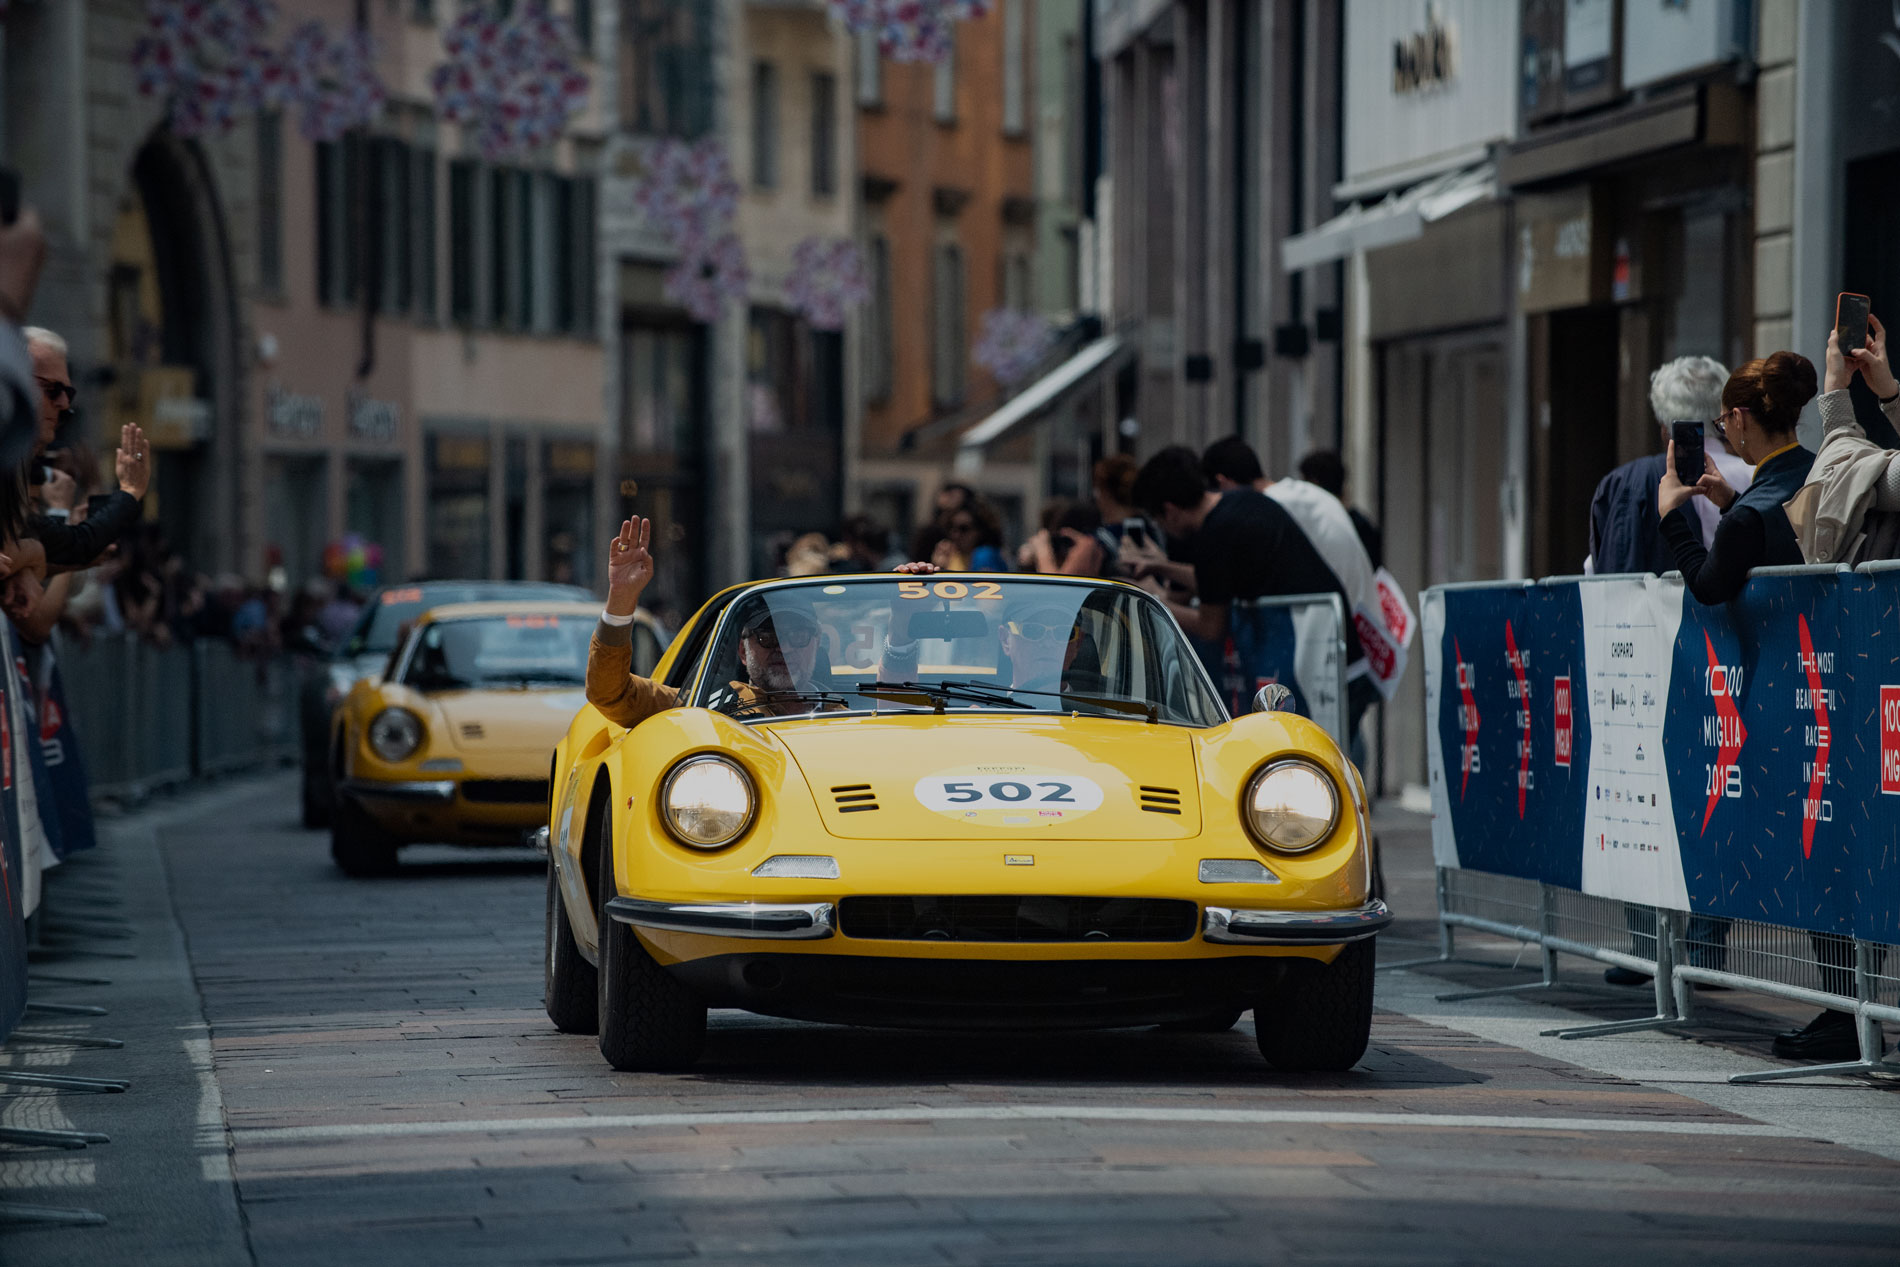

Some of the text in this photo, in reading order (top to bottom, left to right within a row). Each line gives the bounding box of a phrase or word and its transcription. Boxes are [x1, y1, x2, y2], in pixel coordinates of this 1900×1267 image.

[898, 581, 1003, 599] 502
[1612, 642, 1633, 658] CHOPARD
[1798, 652, 1834, 674] THE MOST
[1705, 665, 1743, 697] 1000
[1557, 688, 1569, 715] 1000
[1796, 688, 1836, 711] BEAUTIFUL
[1704, 715, 1741, 747] MIGLIA
[1805, 725, 1828, 747] RACE
[1706, 763, 1742, 798] 2018
[1803, 762, 1831, 784] IN THE
[944, 782, 1075, 802] 502
[1803, 798, 1832, 822] WORLD
